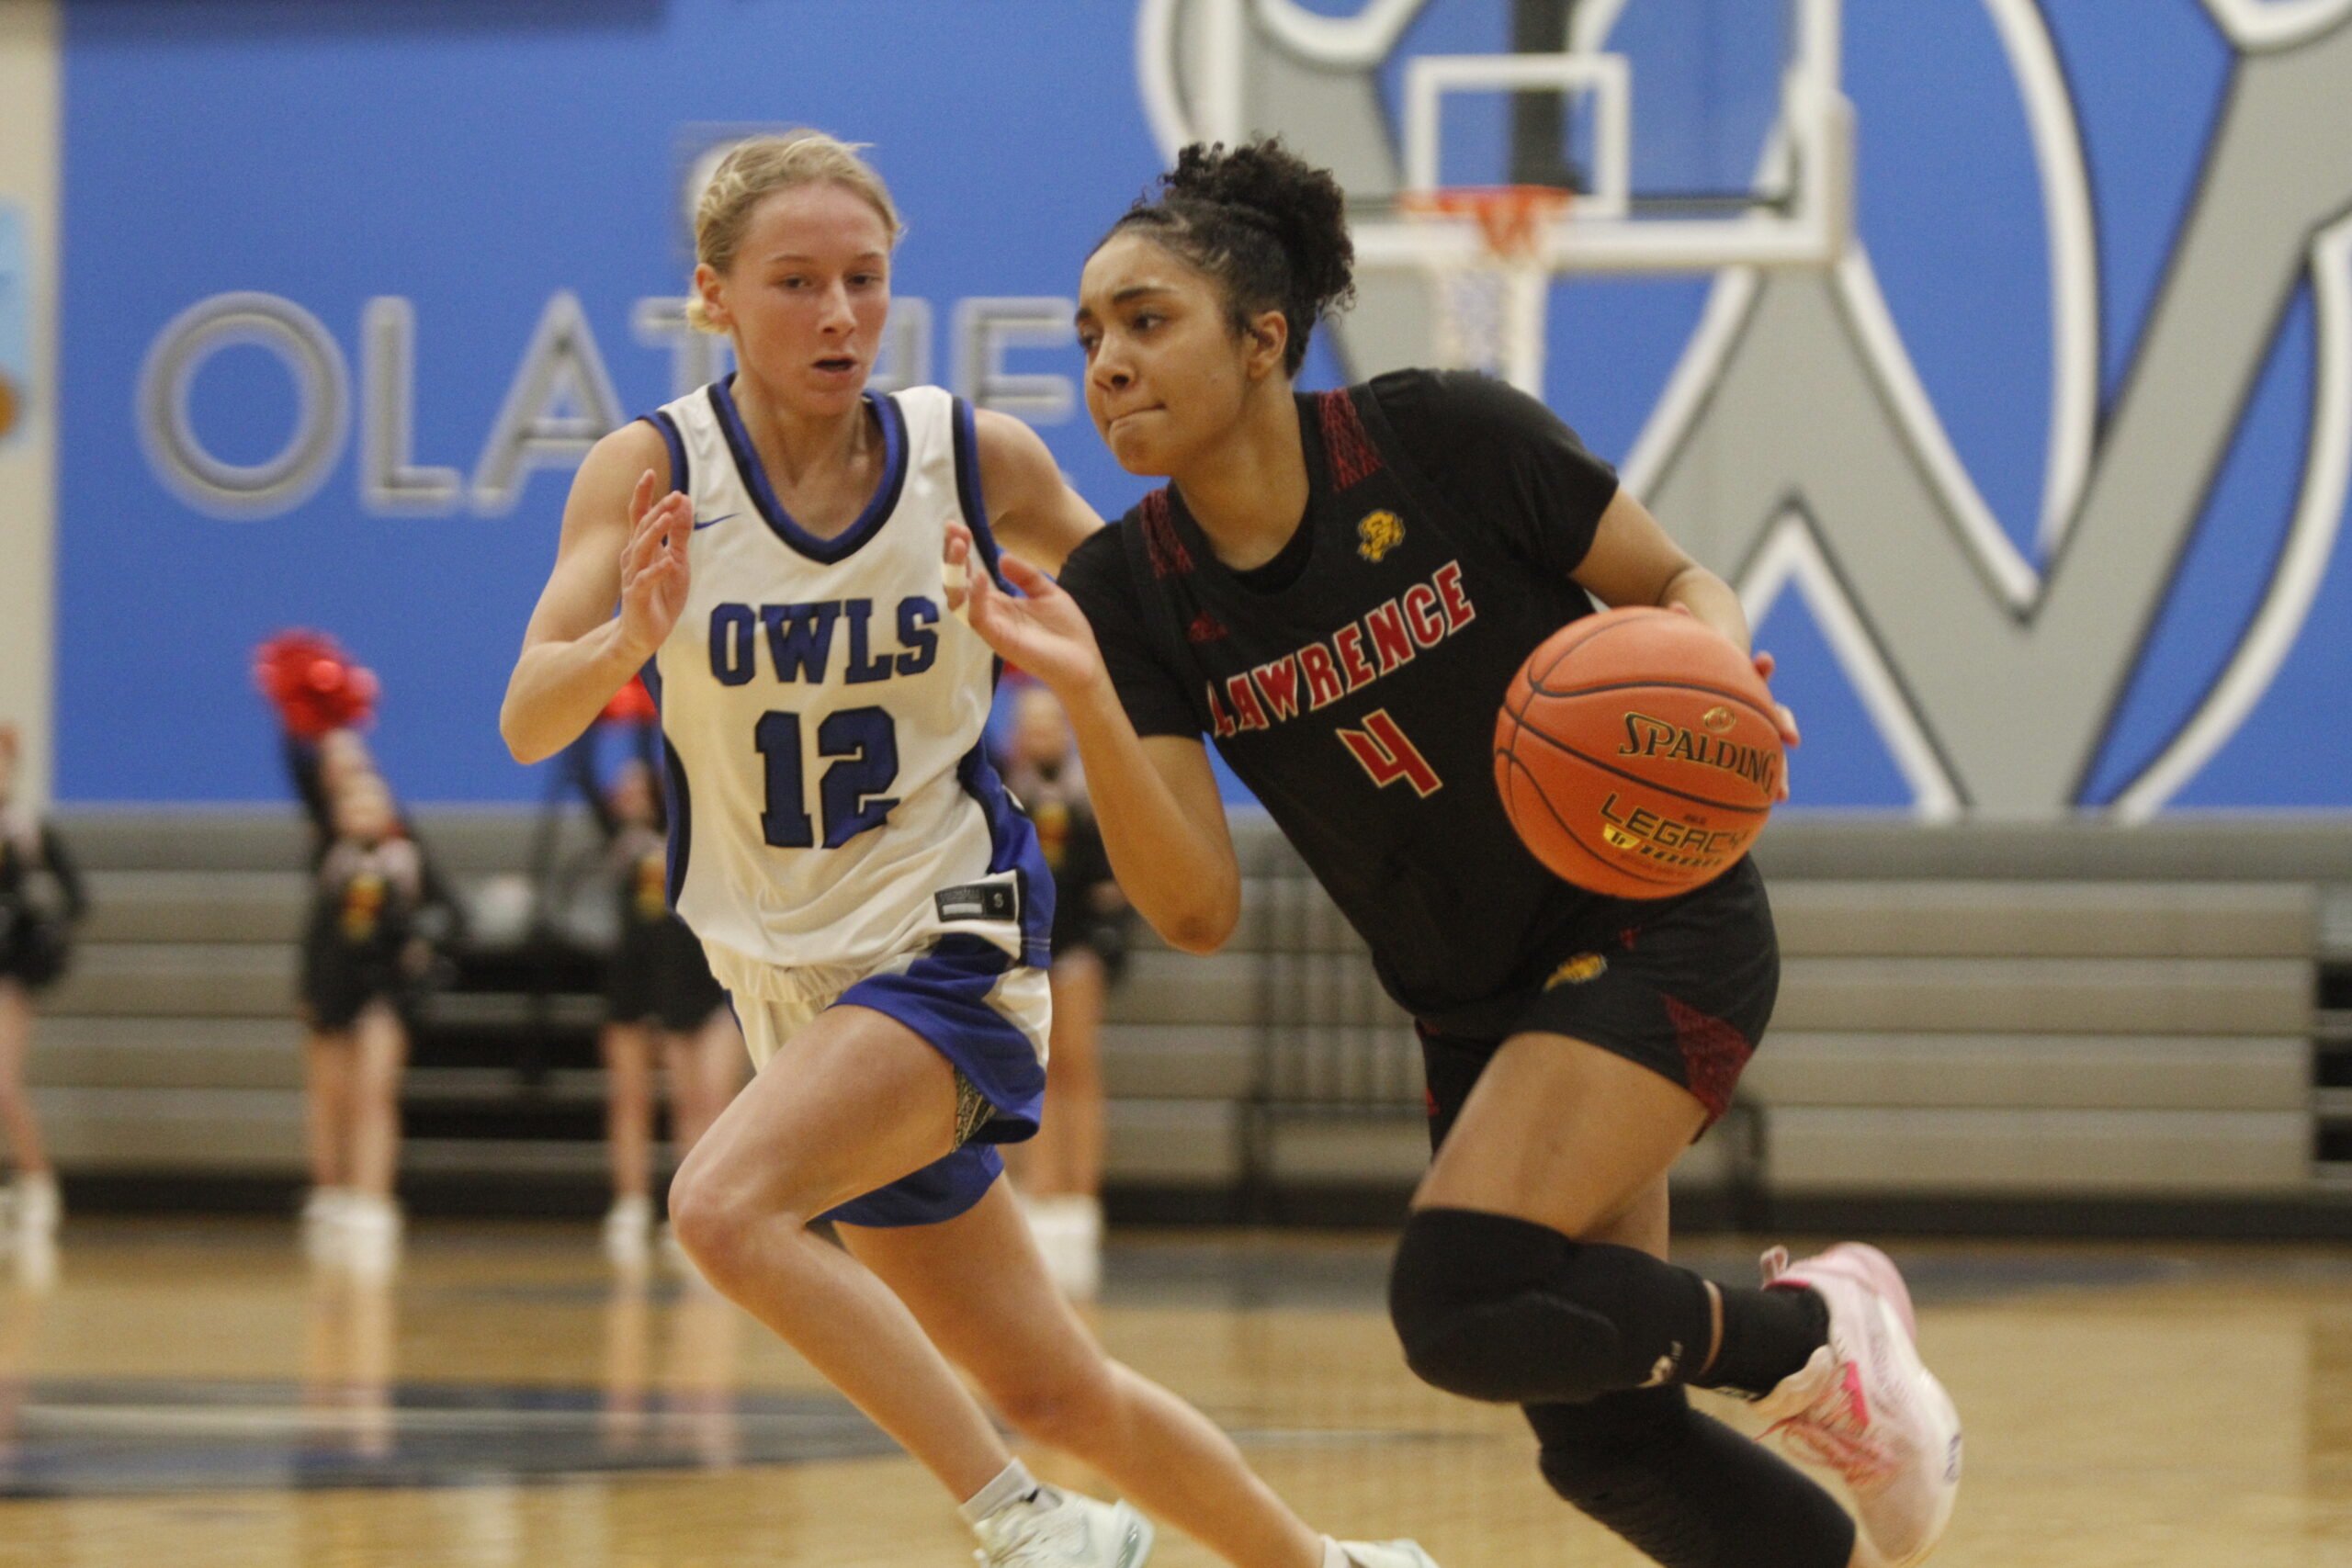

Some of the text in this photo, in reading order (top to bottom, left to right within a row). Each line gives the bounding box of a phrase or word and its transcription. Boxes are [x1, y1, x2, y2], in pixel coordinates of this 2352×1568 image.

[708, 595, 939, 686] OWLS
[1207, 558, 1476, 738] LAWRENCE
[754, 705, 900, 849] 12
[1335, 707, 1442, 798] 4
[1618, 711, 1776, 795] SPALDING
